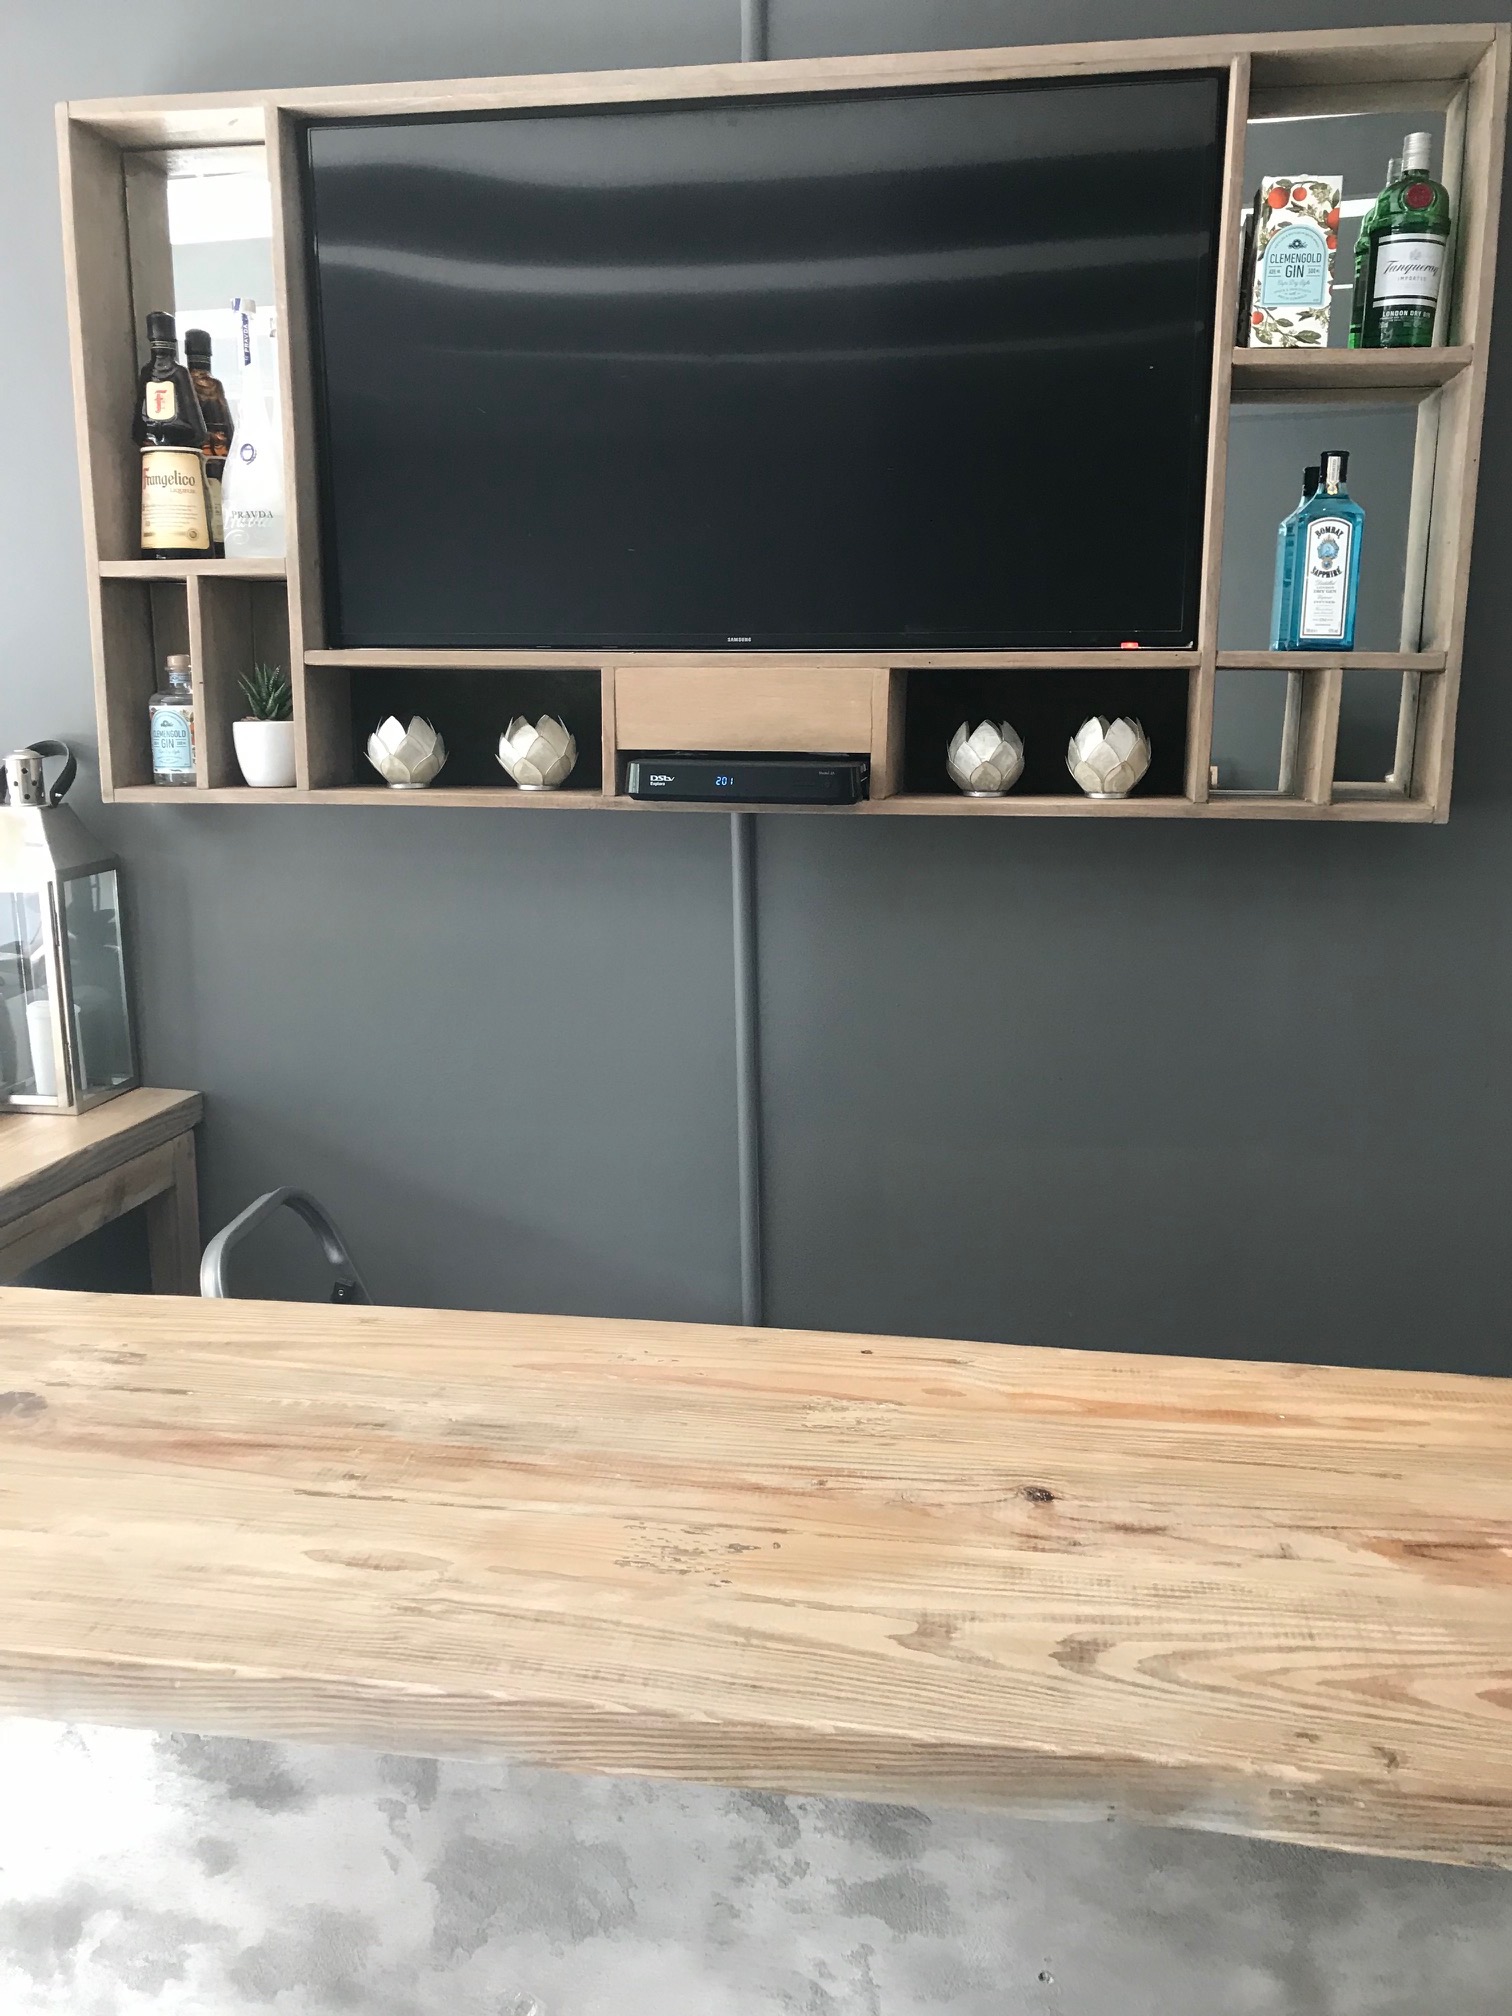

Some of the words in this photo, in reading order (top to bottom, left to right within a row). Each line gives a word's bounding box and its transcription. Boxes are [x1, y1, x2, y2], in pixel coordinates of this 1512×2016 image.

[1269, 252, 1322, 264] CLEMENGOLD
[1285, 264, 1305, 278] GIN
[1383, 260, 1440, 277] Tanqueray
[1382, 310, 1408, 318] LONDON
[231, 510, 274, 519] PRAVDA
[1314, 526, 1344, 539] BOMBAY
[1310, 566, 1343, 578] SAPPHIRE
[160, 738, 175, 749] GIN
[649, 774, 675, 782] DStv
[715, 776, 734, 786] 201
